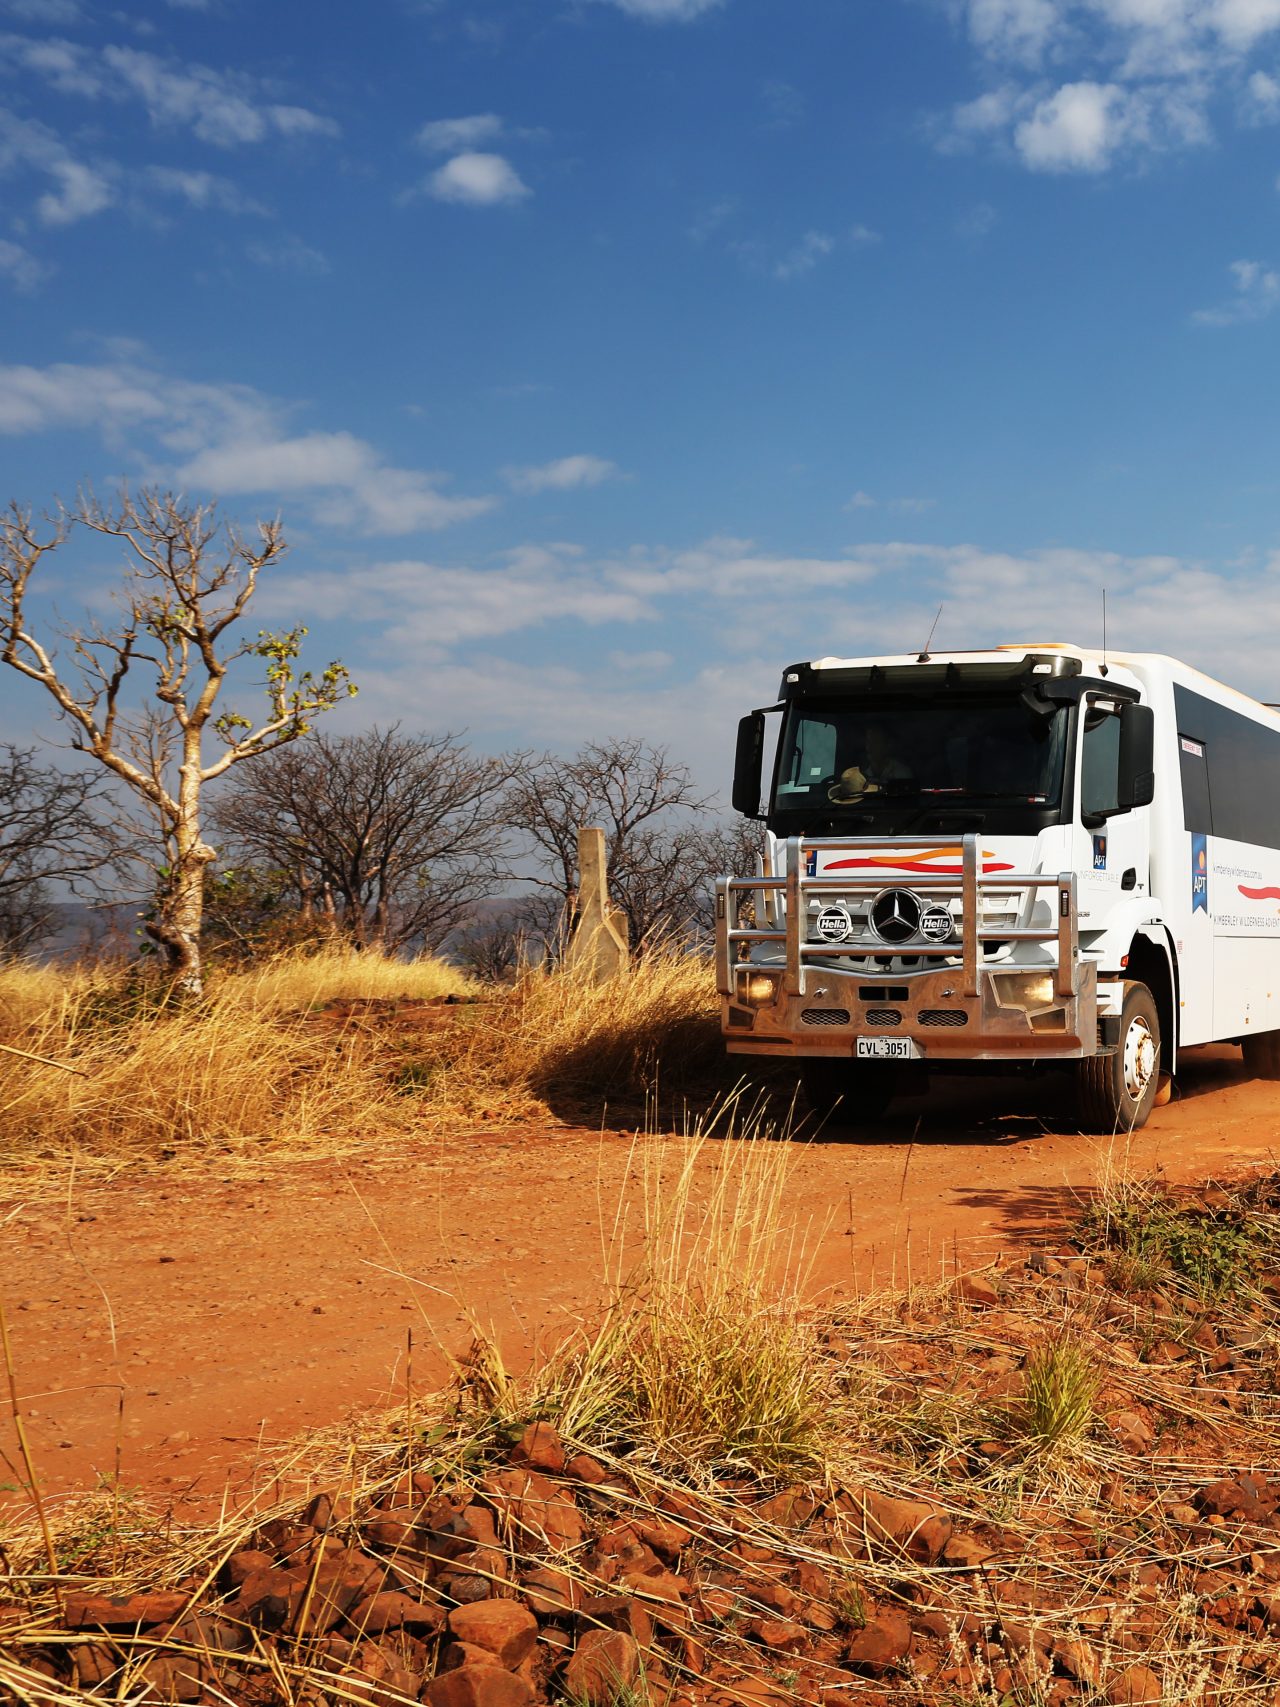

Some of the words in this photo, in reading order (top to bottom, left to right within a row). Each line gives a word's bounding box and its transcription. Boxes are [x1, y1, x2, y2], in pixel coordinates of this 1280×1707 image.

[1094, 854, 1105, 867] APT
[1193, 876, 1206, 893] APT
[821, 919, 846, 929] Hella
[923, 919, 949, 929] Hella
